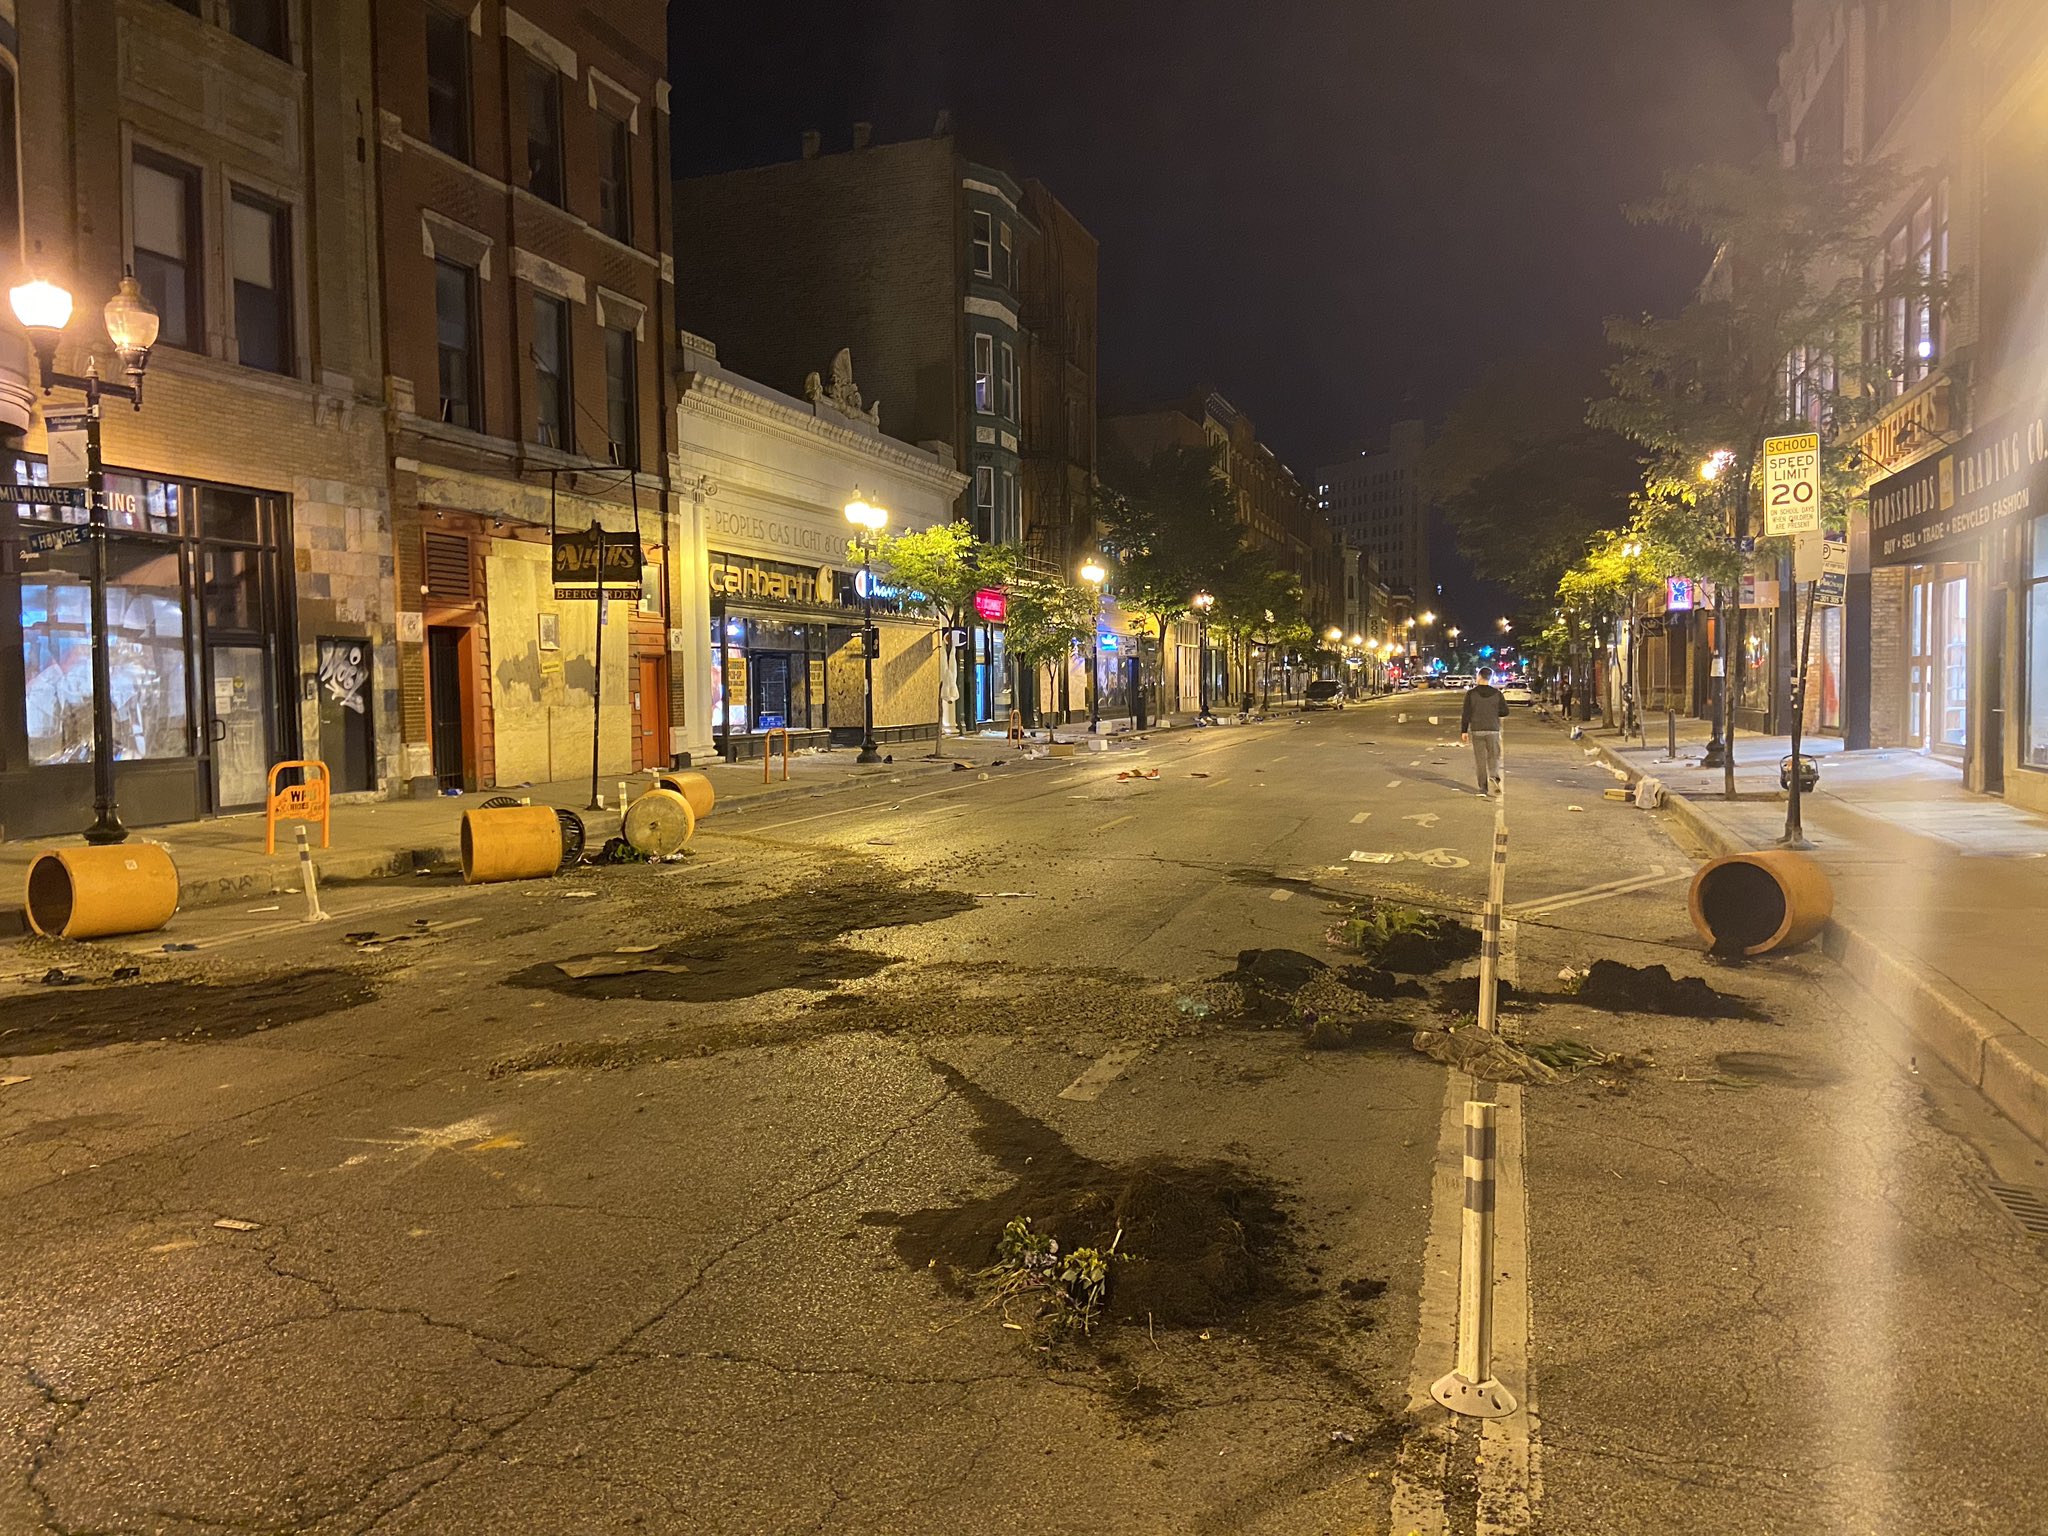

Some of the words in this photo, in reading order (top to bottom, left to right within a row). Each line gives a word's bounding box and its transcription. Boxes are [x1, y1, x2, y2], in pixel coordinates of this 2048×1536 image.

[1768, 438, 1815, 452] SCHOOL
[1769, 455, 1814, 469] SPEED
[1774, 468, 1809, 481] LIMIT
[1873, 475, 1934, 531] CROSSROADS
[1959, 432, 2019, 496] TRADING
[2027, 418, 2047, 465] CO.
[0, 488, 71, 504] MILWAUKEE
[1771, 481, 1813, 505] 20
[1780, 507, 1799, 515] SCHOOL
[1788, 513, 1813, 521] CHILDREN
[1787, 521, 1810, 529] PRESENT
[1883, 537, 1896, 555] BUY
[1901, 532, 1917, 549] SELL
[1922, 522, 1945, 544] TRADE
[1951, 505, 1990, 534] RECYCLED
[1992, 487, 2029, 521] FASHION
[715, 510, 764, 540] PEOPLES
[768, 522, 790, 545] GAS
[794, 527, 822, 550] LIGHT
[38, 529, 81, 550] HONORE
[709, 564, 815, 602] carhartt
[557, 589, 639, 599] BEERGRDEN
